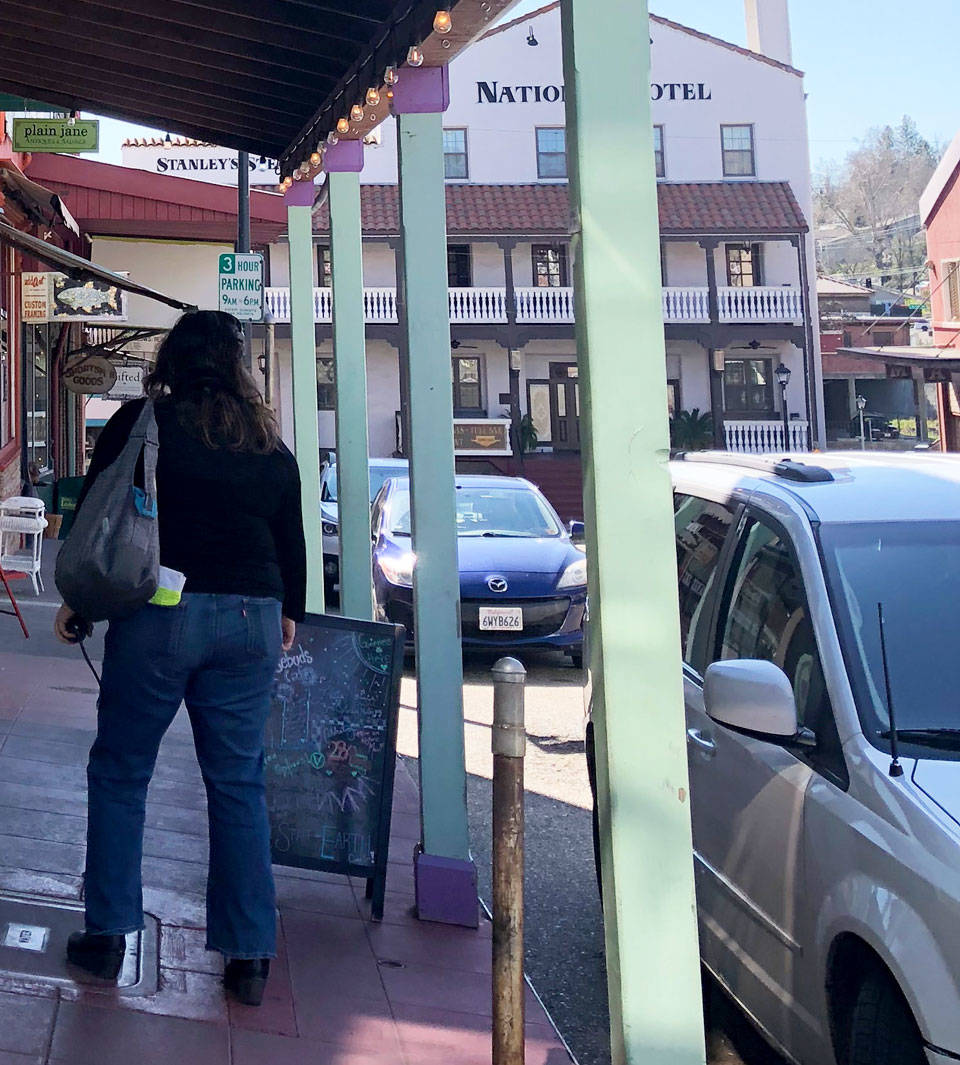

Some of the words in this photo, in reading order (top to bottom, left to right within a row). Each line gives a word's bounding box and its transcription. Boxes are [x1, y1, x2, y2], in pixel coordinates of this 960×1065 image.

[476, 81, 565, 103] NATIO
[651, 83, 712, 101] OTEL
[24, 124, 56, 137] plain
[60, 124, 88, 138] jane
[157, 157, 239, 172] STANLEY'S
[223, 256, 233, 272] 3
[237, 261, 259, 272] HOUR
[221, 278, 260, 291] PARKING
[24, 300, 47, 309] CUSTOM
[72, 376, 104, 386] GOODS
[118, 369, 141, 383] ifted
[482, 615, 520, 627] 6WYB626
